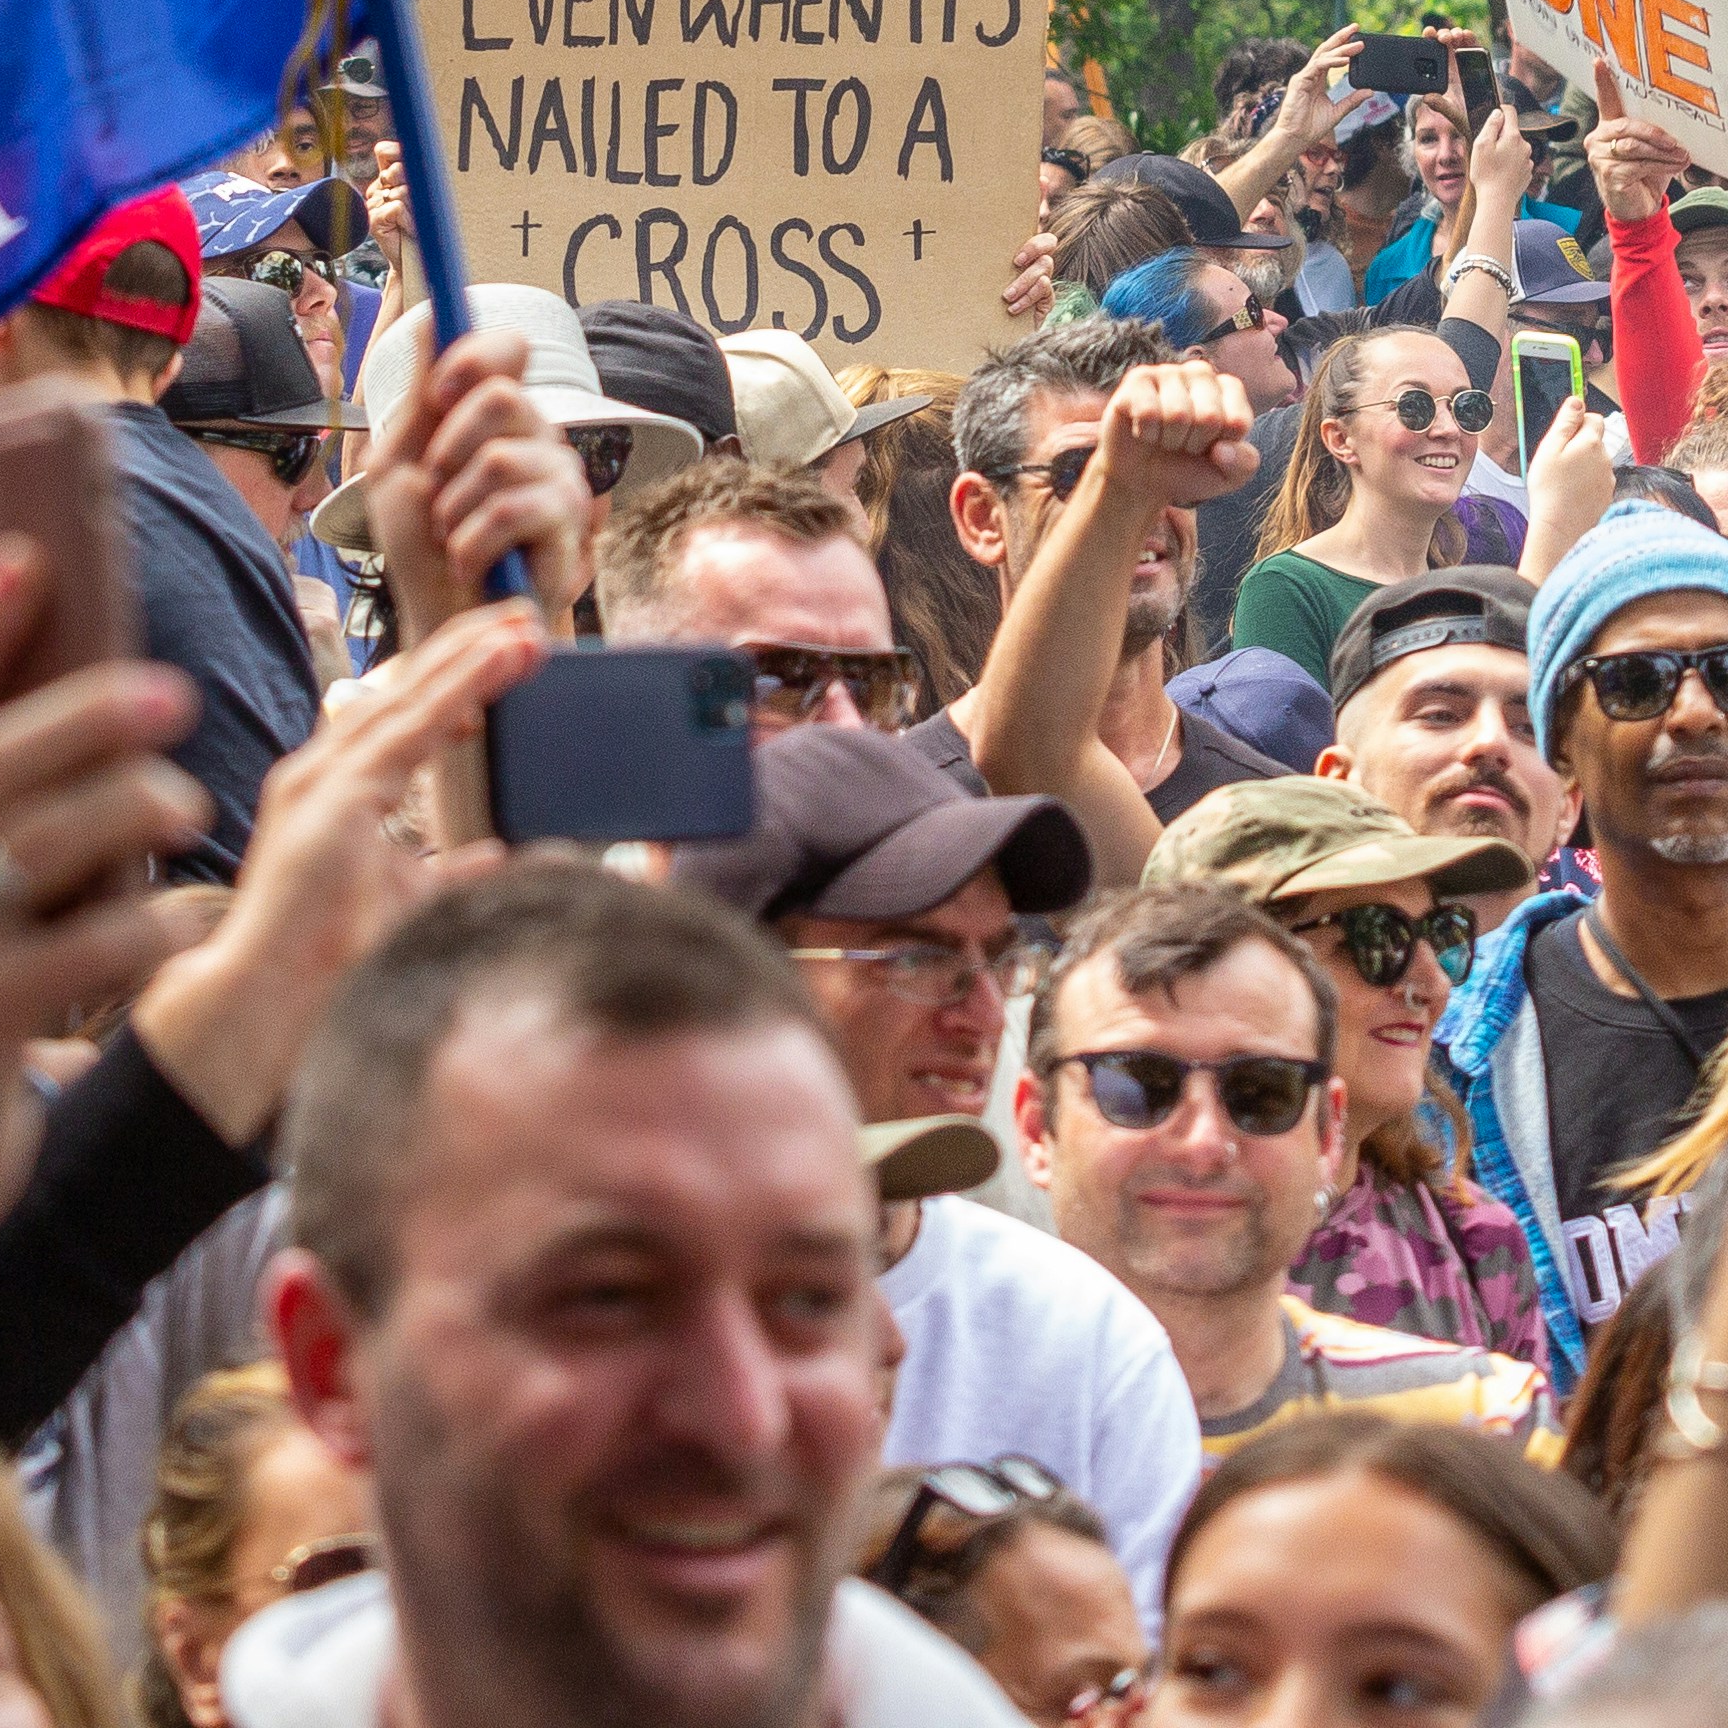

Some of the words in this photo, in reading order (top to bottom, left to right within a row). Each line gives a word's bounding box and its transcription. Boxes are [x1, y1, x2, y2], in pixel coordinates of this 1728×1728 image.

[459, 77, 737, 186] NAILED
[773, 77, 871, 176] TO
[898, 77, 952, 181] A
[563, 207, 881, 345] CROSS
